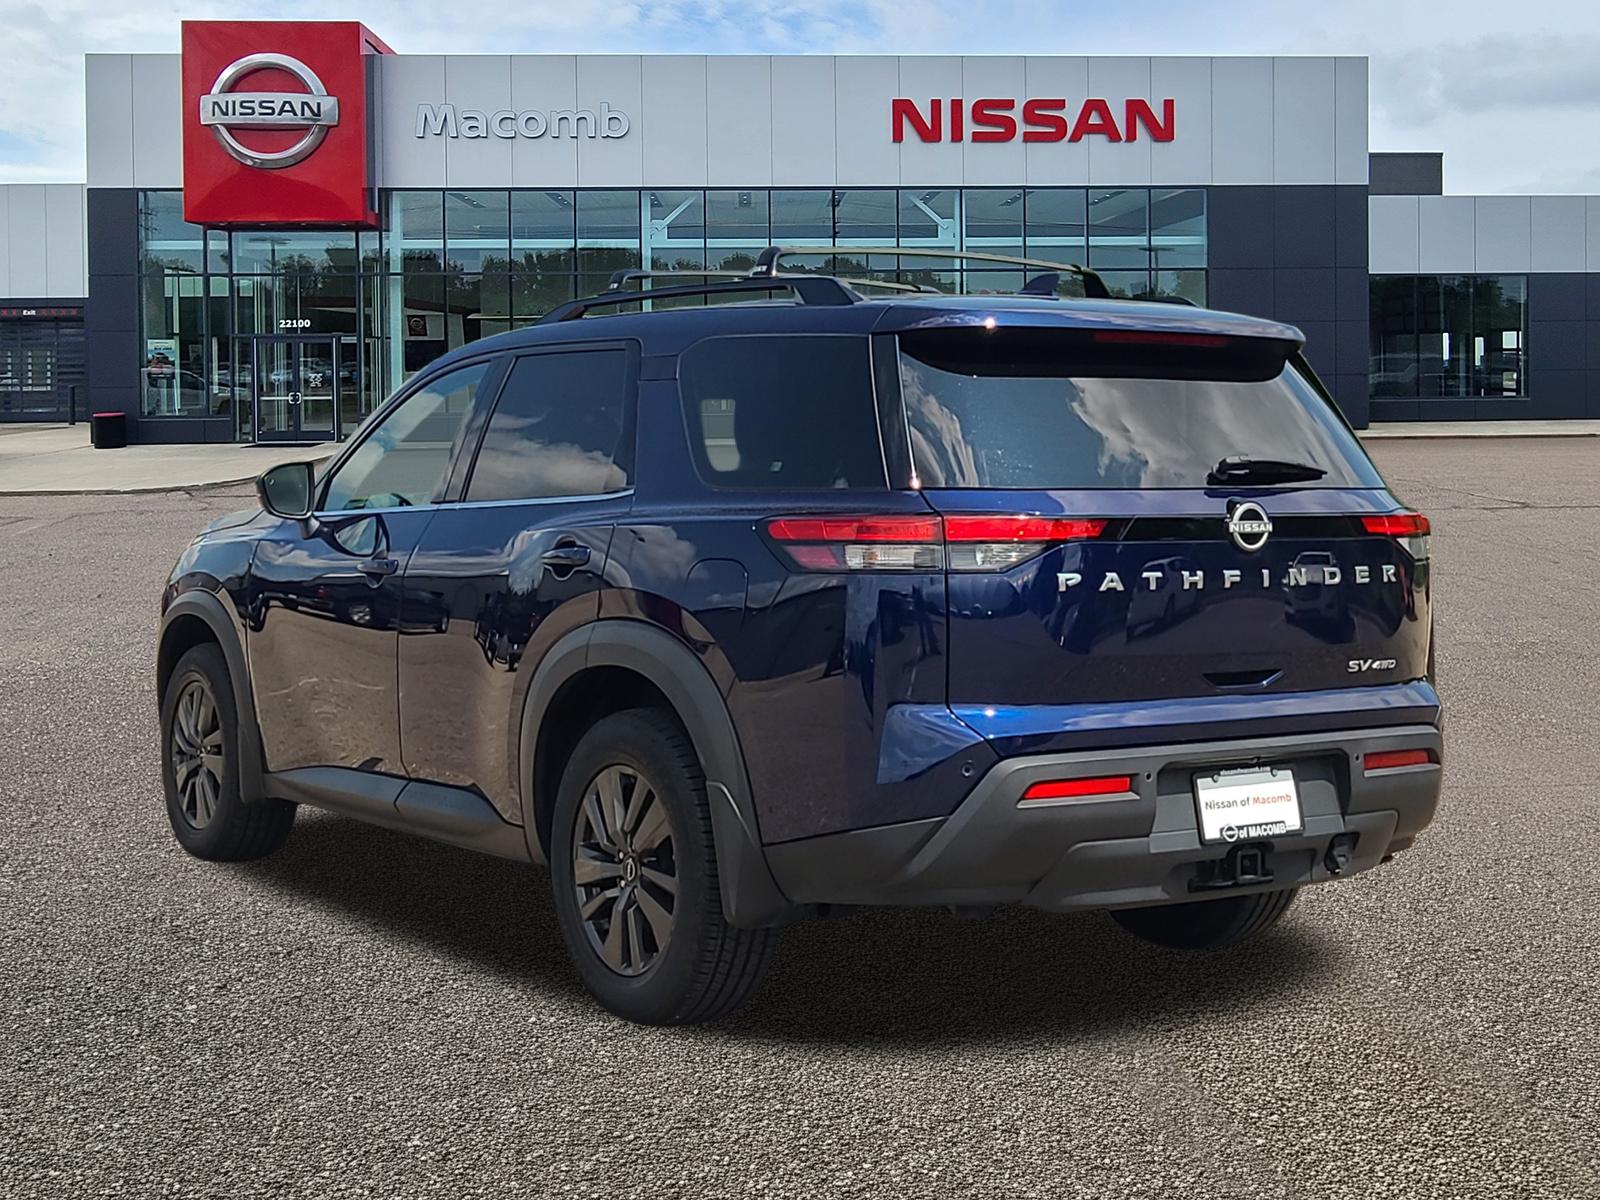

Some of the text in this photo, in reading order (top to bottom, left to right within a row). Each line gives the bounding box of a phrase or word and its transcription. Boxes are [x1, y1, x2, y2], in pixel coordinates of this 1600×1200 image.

[211, 100, 322, 117] NISSAN
[415, 103, 631, 139] Macomb
[892, 98, 1175, 143] NISSAN
[279, 319, 311, 328] 22100
[1230, 523, 1272, 532] NISSAN
[1056, 564, 1397, 592] PATHFINDER
[1347, 659, 1372, 672] SV
[1204, 793, 1292, 810] Nissan of Macomb
[1239, 822, 1287, 838] of MACOMB
